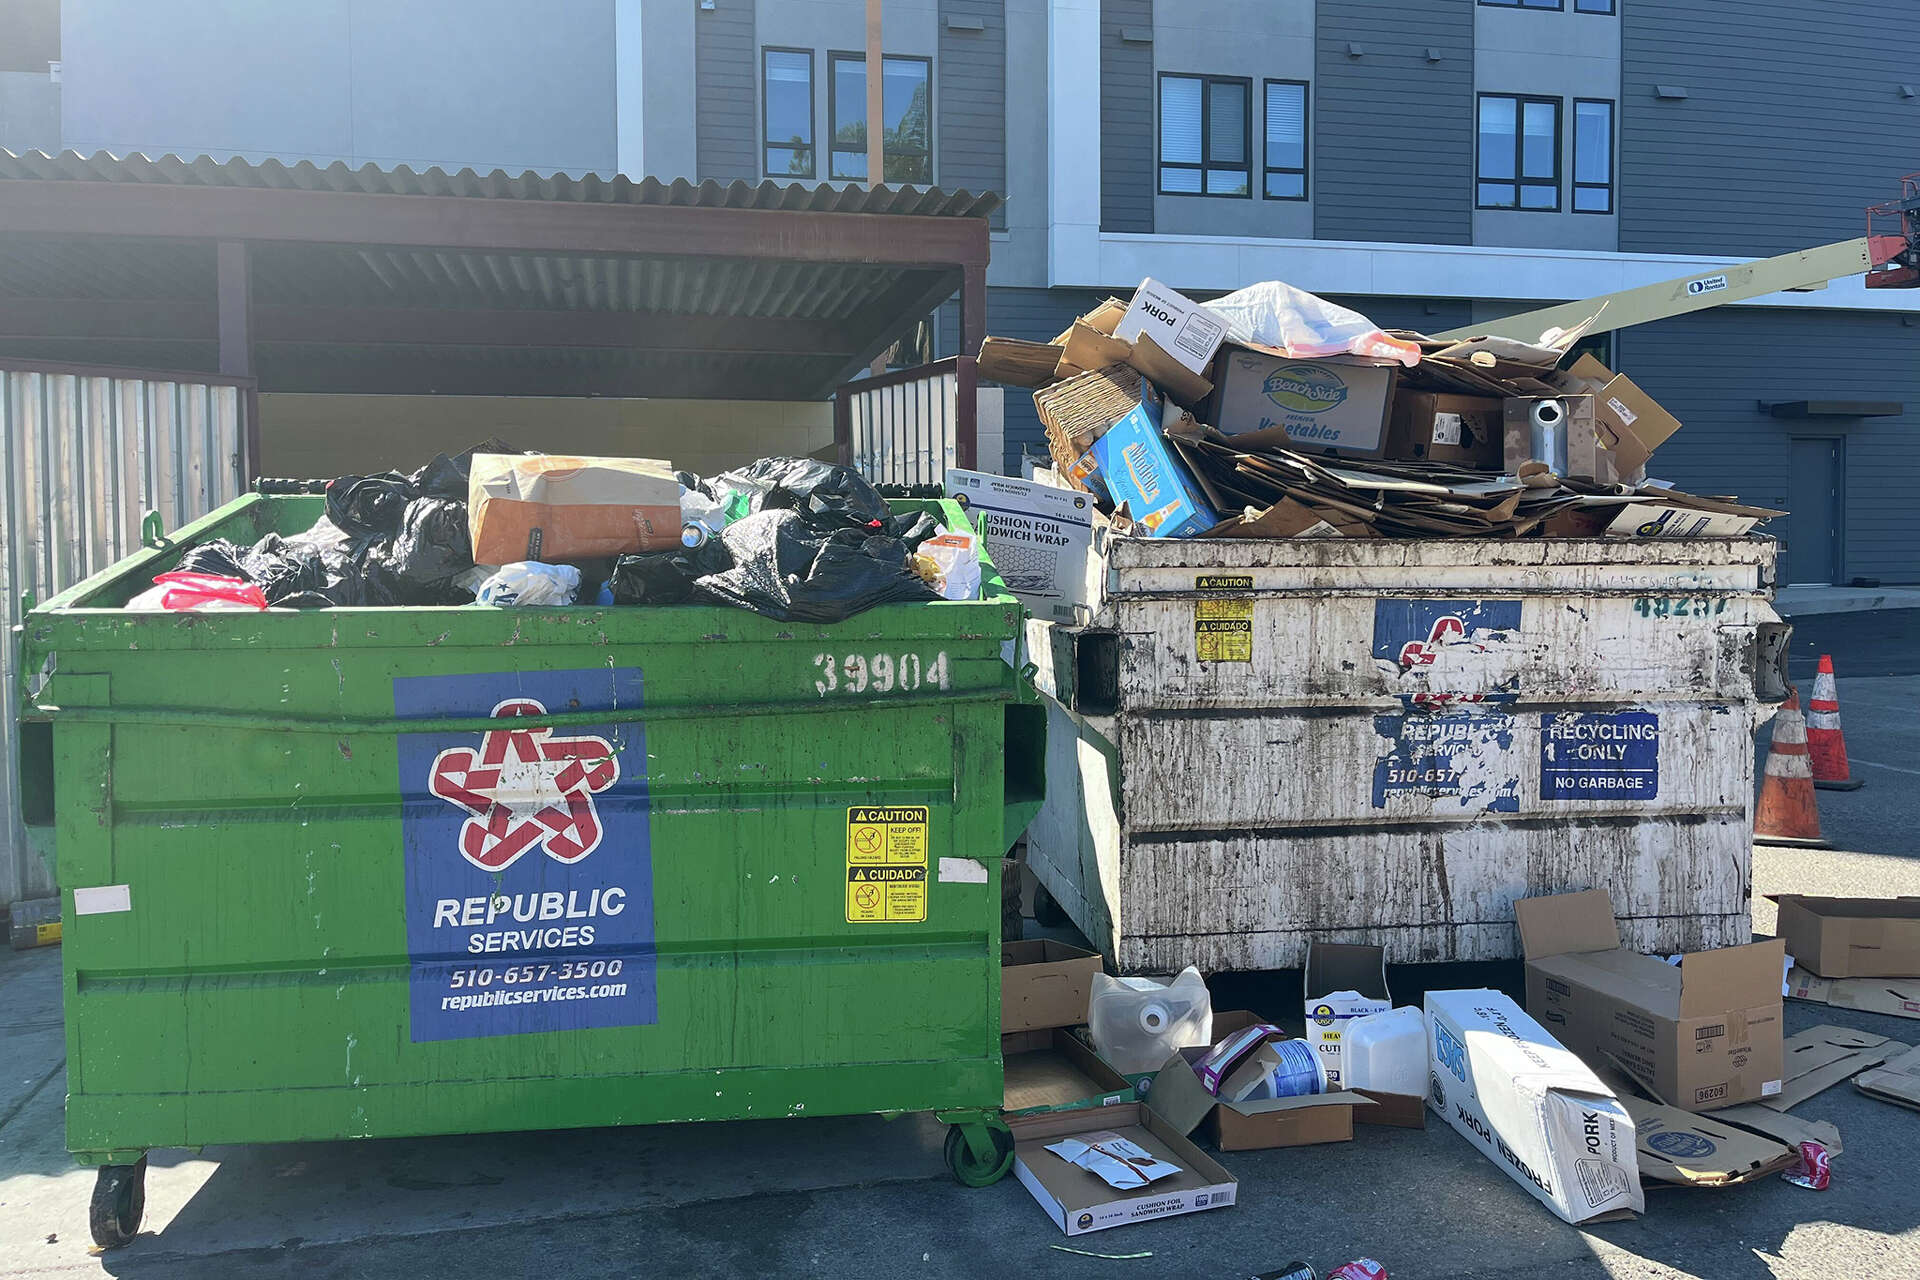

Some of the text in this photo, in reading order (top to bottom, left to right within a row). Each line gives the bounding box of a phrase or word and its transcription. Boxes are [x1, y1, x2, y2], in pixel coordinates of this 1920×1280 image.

[1704, 277, 1723, 285] United
[1141, 301, 1177, 327] PORK
[1286, 414, 1316, 423] PREMIUM
[1258, 416, 1342, 441] Veetables
[1129, 442, 1160, 494] Modelo
[977, 513, 1062, 535] USHION FOIL
[1034, 533, 1070, 547] WRAP
[1209, 578, 1250, 587] CAUTION
[1210, 622, 1249, 631] CUIDADO
[814, 651, 949, 692] 39904
[1550, 723, 1655, 740] RECYCLING
[1578, 744, 1628, 760] ONLY
[1555, 776, 1644, 789] NO GARBAGE
[868, 810, 923, 821] CAUTION
[869, 869, 924, 880] CUIDADO
[433, 887, 626, 928] REPUBLIC
[467, 925, 596, 954] SERVICES
[450, 959, 624, 989] 510-657-3500
[441, 982, 627, 1012] republicservices.com
[1699, 1087, 1724, 1101] 60296
[1456, 1103, 1491, 1144] PORK
[1582, 1112, 1601, 1155] PORK
[1610, 1132, 1616, 1140] OF
[1610, 1139, 1618, 1163] PRODUCT
[1496, 1138, 1553, 1196] FROZEN
[1130, 1203, 1184, 1218] SANDWICH WRAP
[1136, 1201, 1165, 1210] CUSHION
